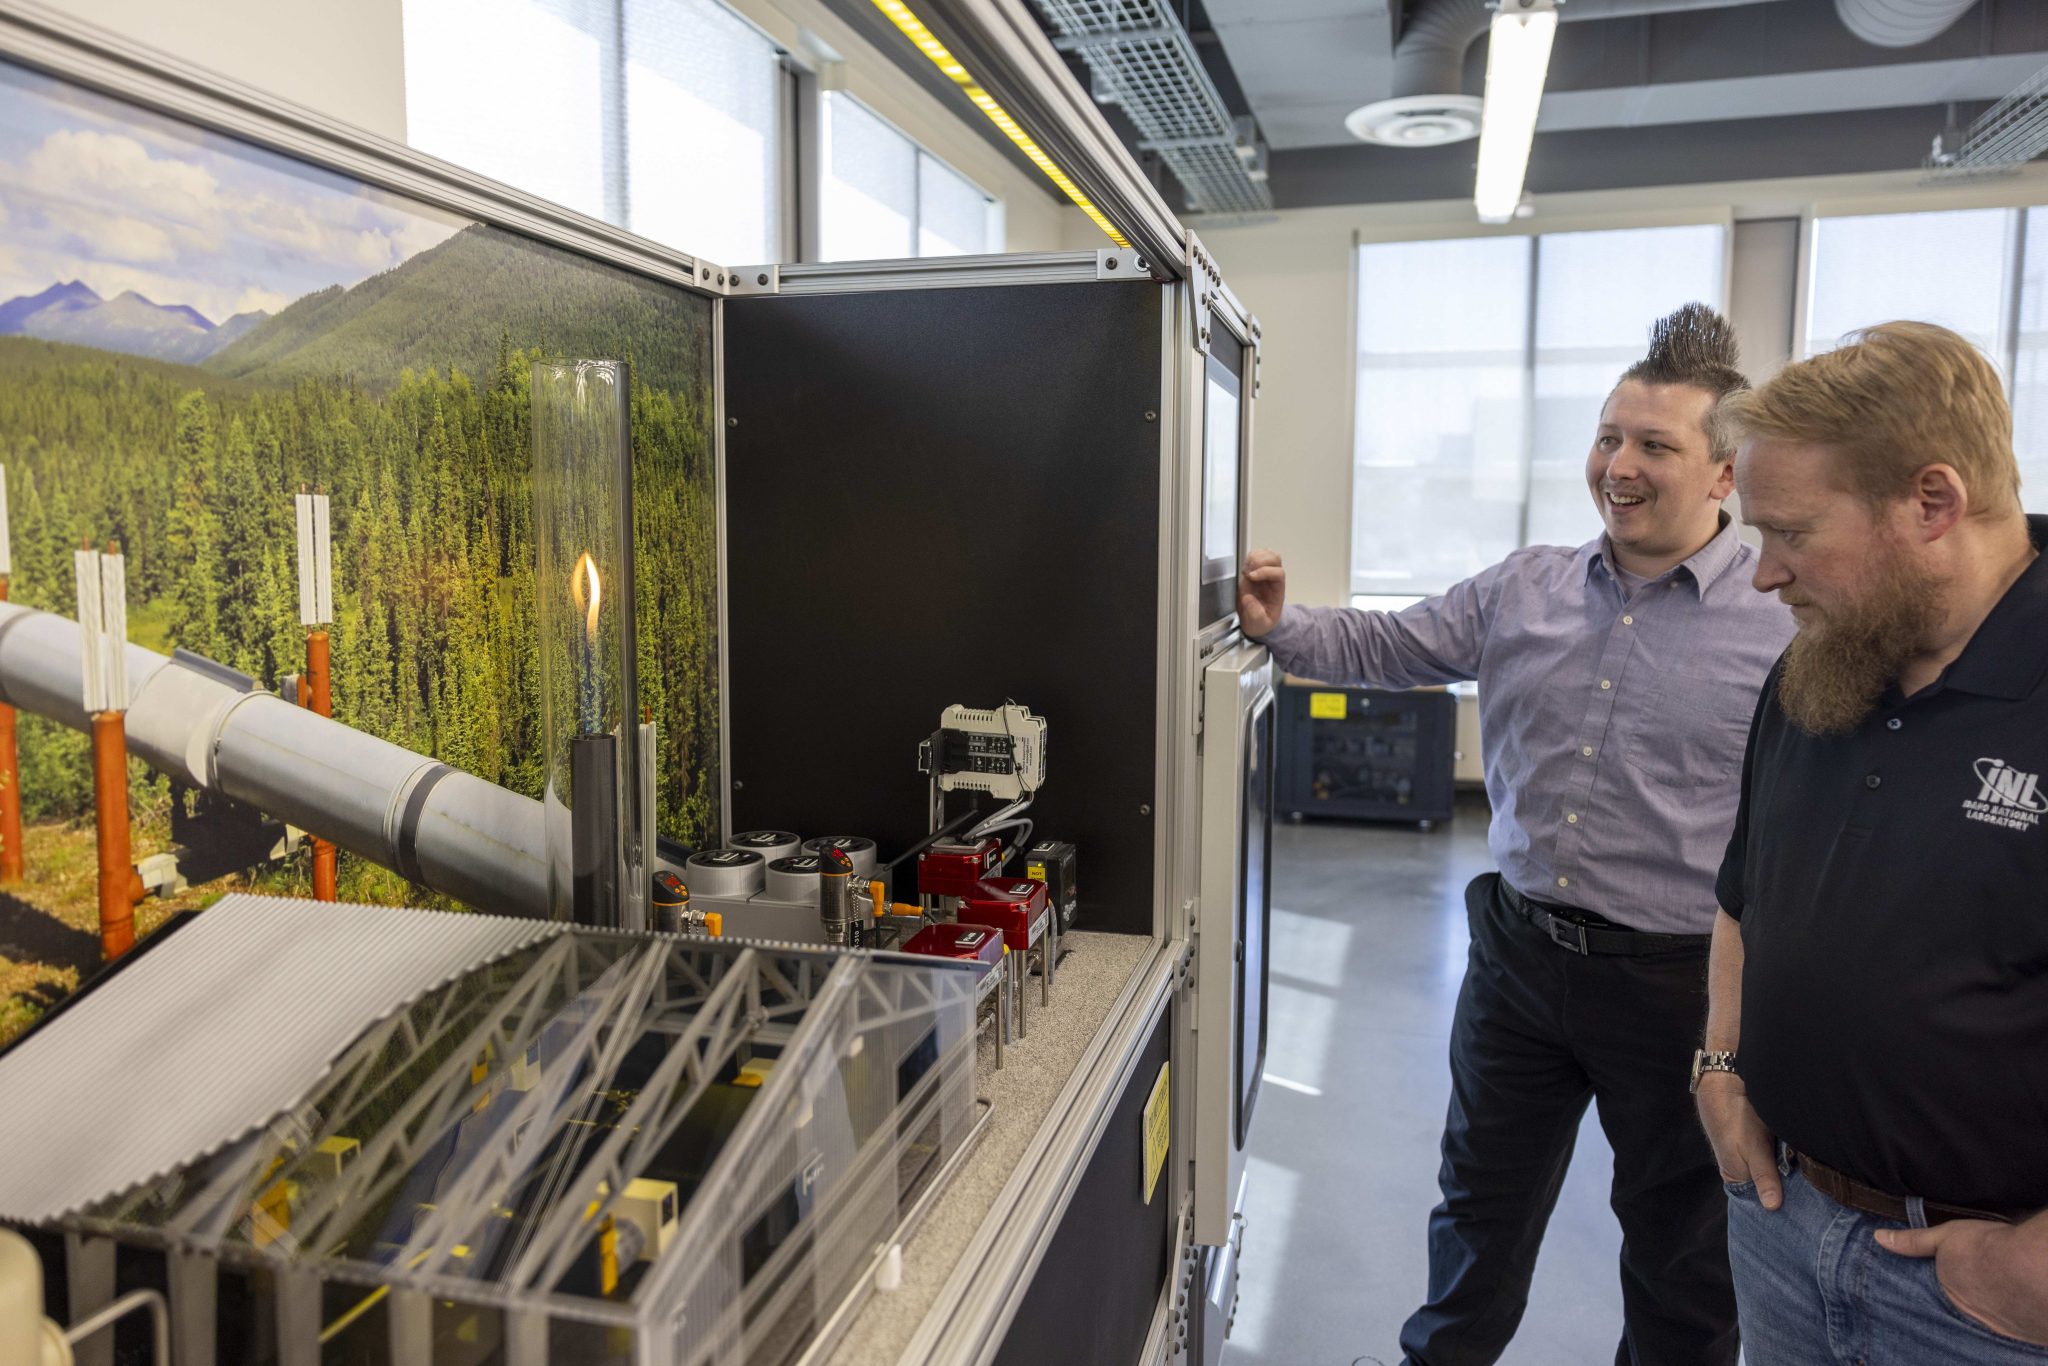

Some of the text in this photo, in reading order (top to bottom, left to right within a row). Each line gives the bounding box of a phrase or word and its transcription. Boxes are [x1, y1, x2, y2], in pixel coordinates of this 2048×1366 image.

[1977, 767, 2039, 809] INL
[1962, 800, 2039, 824] IDAHO NATIONAL
[1966, 809, 2029, 832] LABORATORY
